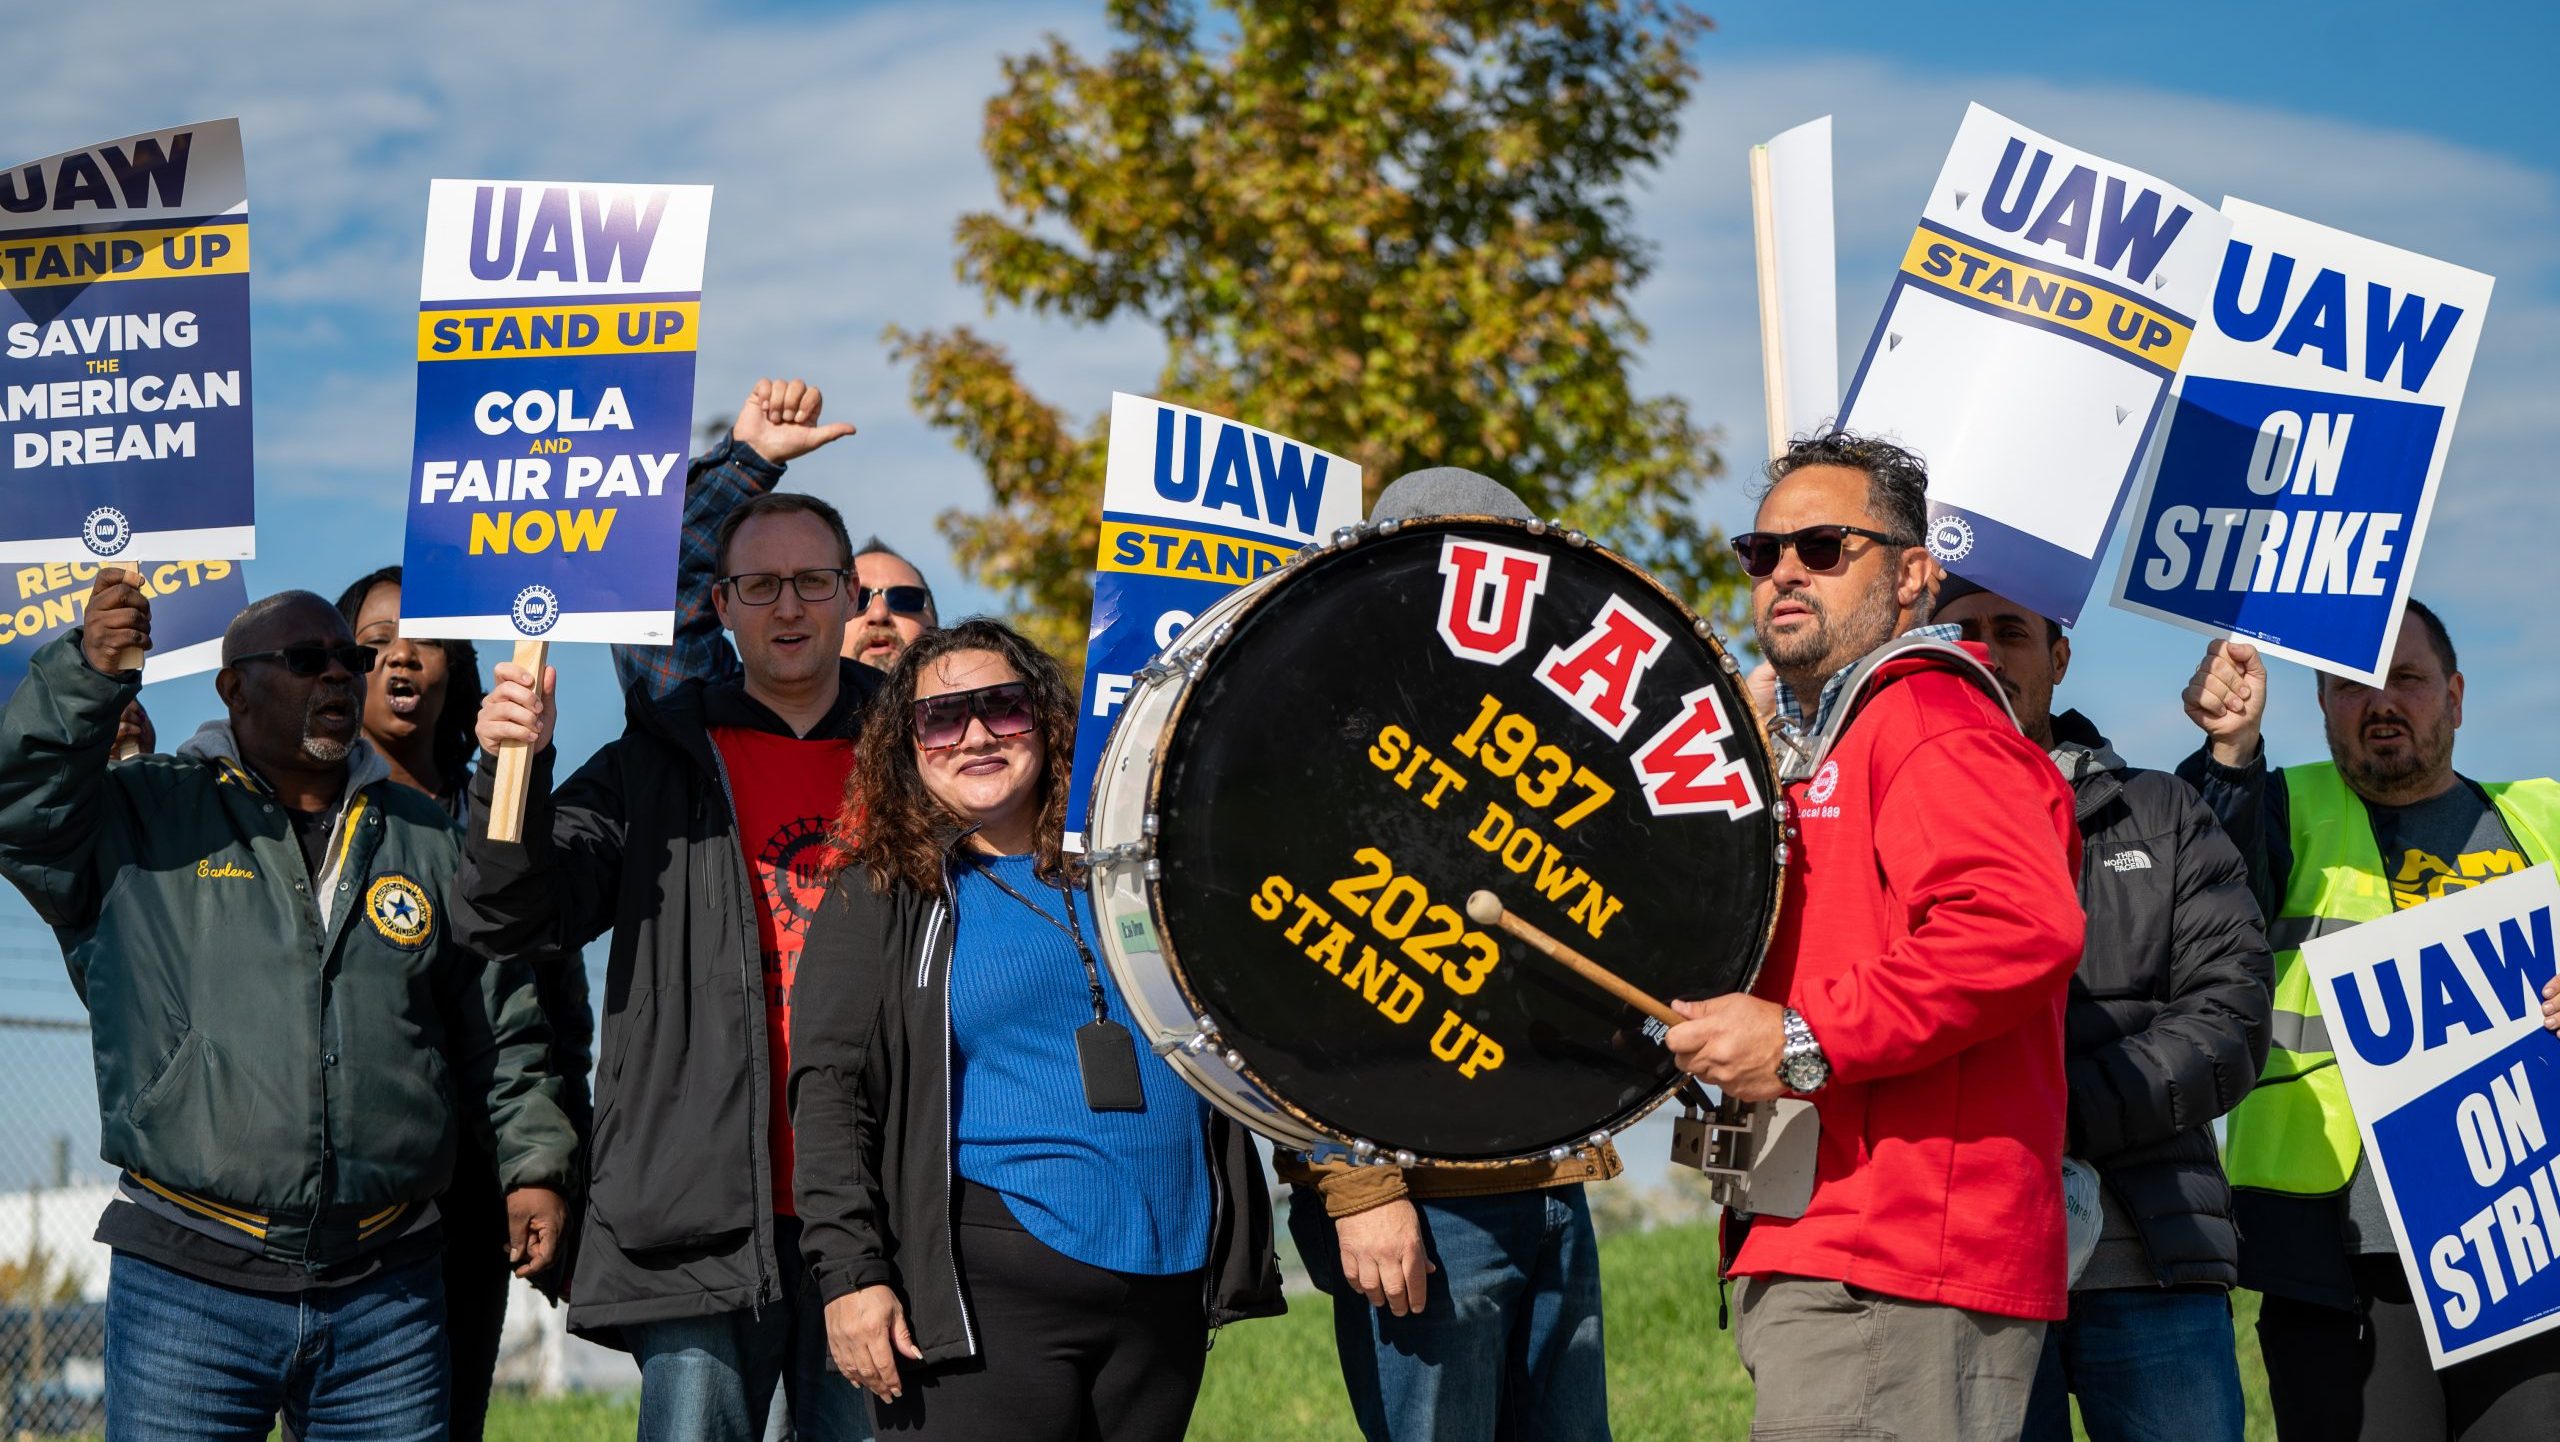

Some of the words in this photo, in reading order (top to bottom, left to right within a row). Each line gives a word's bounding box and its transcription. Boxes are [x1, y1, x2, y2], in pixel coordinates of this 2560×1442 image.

[0, 132, 193, 214] UAW
[469, 186, 670, 284] UAW
[1981, 136, 2193, 286] UAW
[0, 239, 144, 284] TAND
[162, 233, 231, 270] UP
[1920, 243, 2093, 322] STAND
[2106, 299, 2172, 352] UP
[2212, 239, 2465, 395] UAW
[6, 311, 199, 359] SAVING
[431, 313, 600, 354] STAND
[617, 310, 685, 346] UP
[86, 358, 119, 374] THE
[0, 370, 241, 422] MERICAN
[474, 387, 634, 436] COLA
[14, 421, 196, 469] DREAM
[529, 437, 573, 455] AND
[2246, 410, 2354, 496] ON
[420, 458, 552, 504] FAIR
[564, 453, 681, 500] PAY
[1153, 406, 1329, 537] UAW
[96, 524, 115, 536] UAW
[469, 508, 618, 556] NOW
[1113, 531, 1282, 580] STAND
[1938, 530, 1961, 546] UAW
[2144, 505, 2401, 596] STRIKE
[525, 603, 545, 615] UAW
[1436, 534, 1764, 821] UAW
[1451, 693, 1616, 831] 1937
[1367, 724, 1467, 810] SIT
[1467, 802, 1624, 941] DOWN
[1821, 805, 1841, 819] 889
[197, 858, 255, 880] Earlene
[2103, 856, 2136, 868] NORTH
[2114, 850, 2134, 860] THE
[2114, 862, 2137, 873] FACE
[375, 882, 408, 911] AMERICAN
[1327, 846, 1500, 998] 2023
[1249, 874, 1425, 1026] STAND
[1428, 1008, 1506, 1082] UP
[2330, 905, 2558, 1067] UAW
[2455, 1059, 2547, 1189] ON
[2429, 1152, 2560, 1331] STRI
